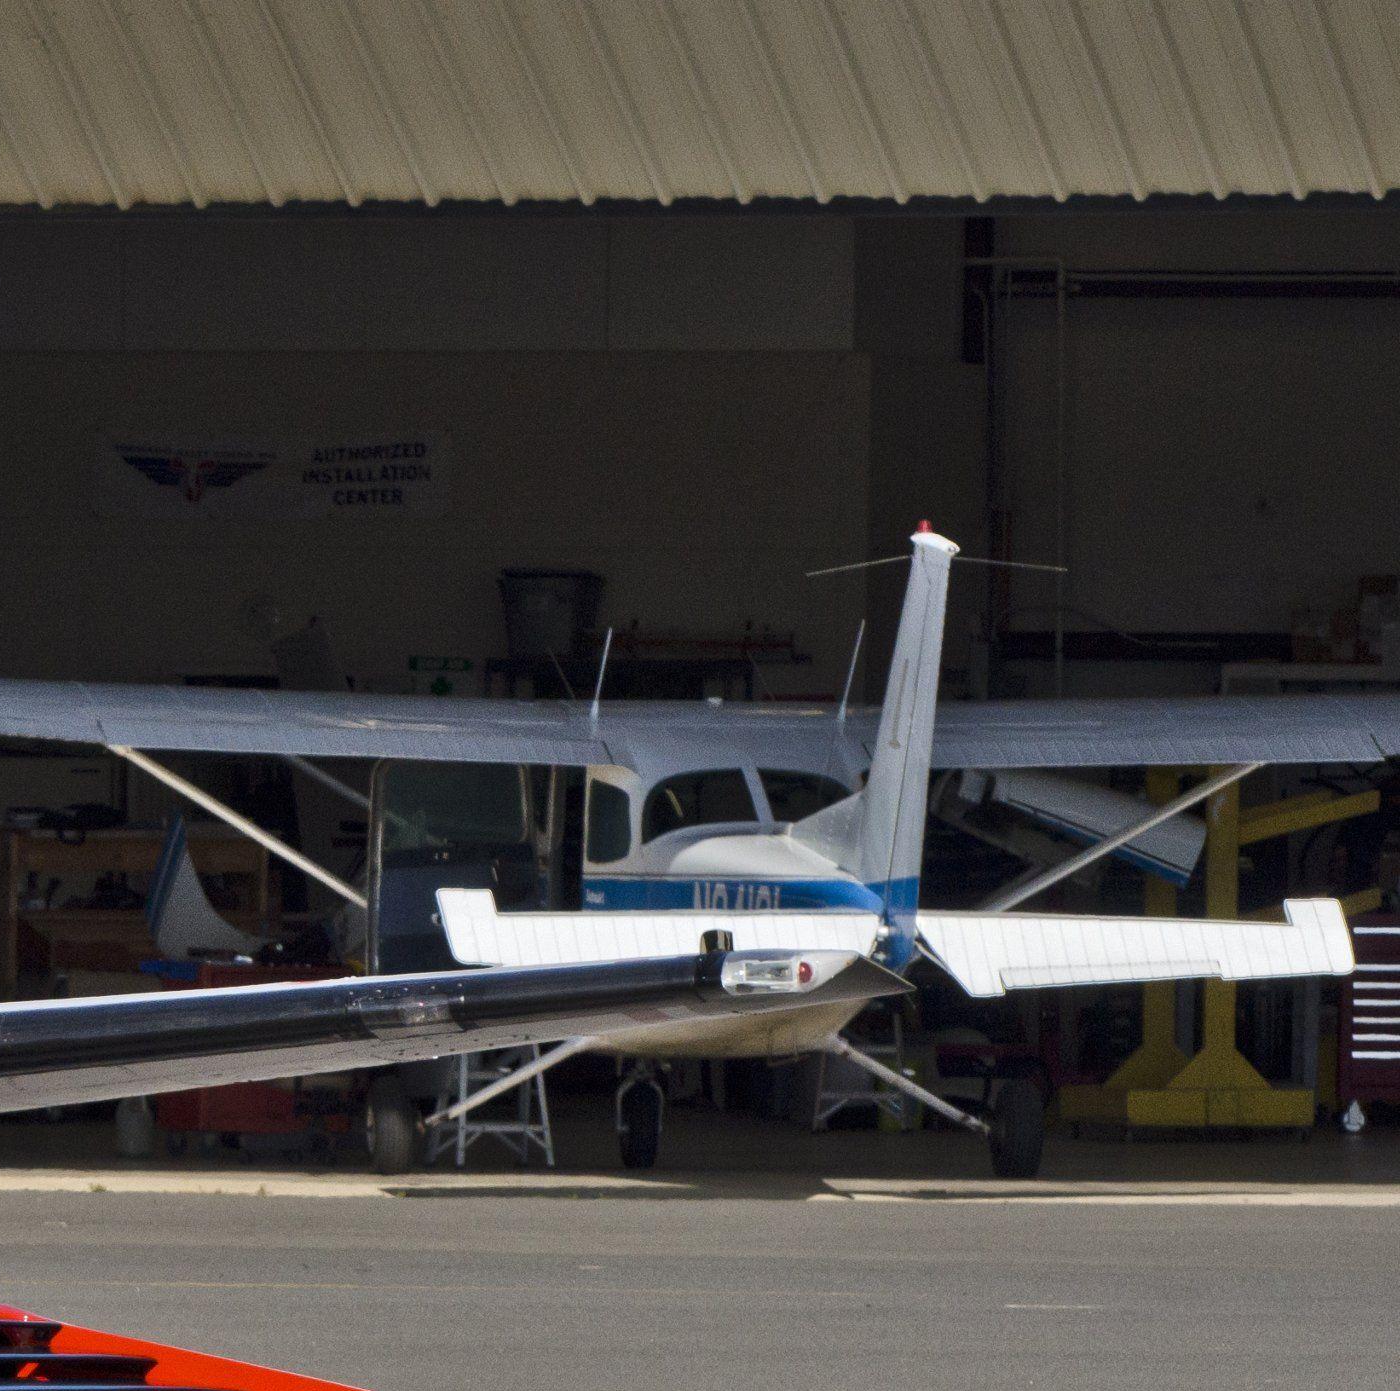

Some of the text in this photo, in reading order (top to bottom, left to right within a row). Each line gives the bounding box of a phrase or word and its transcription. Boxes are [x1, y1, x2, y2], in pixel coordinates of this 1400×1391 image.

[312, 442, 427, 464] AUTHORIZED
[301, 465, 431, 484] INSTALLATION
[333, 489, 403, 505] CENTER
